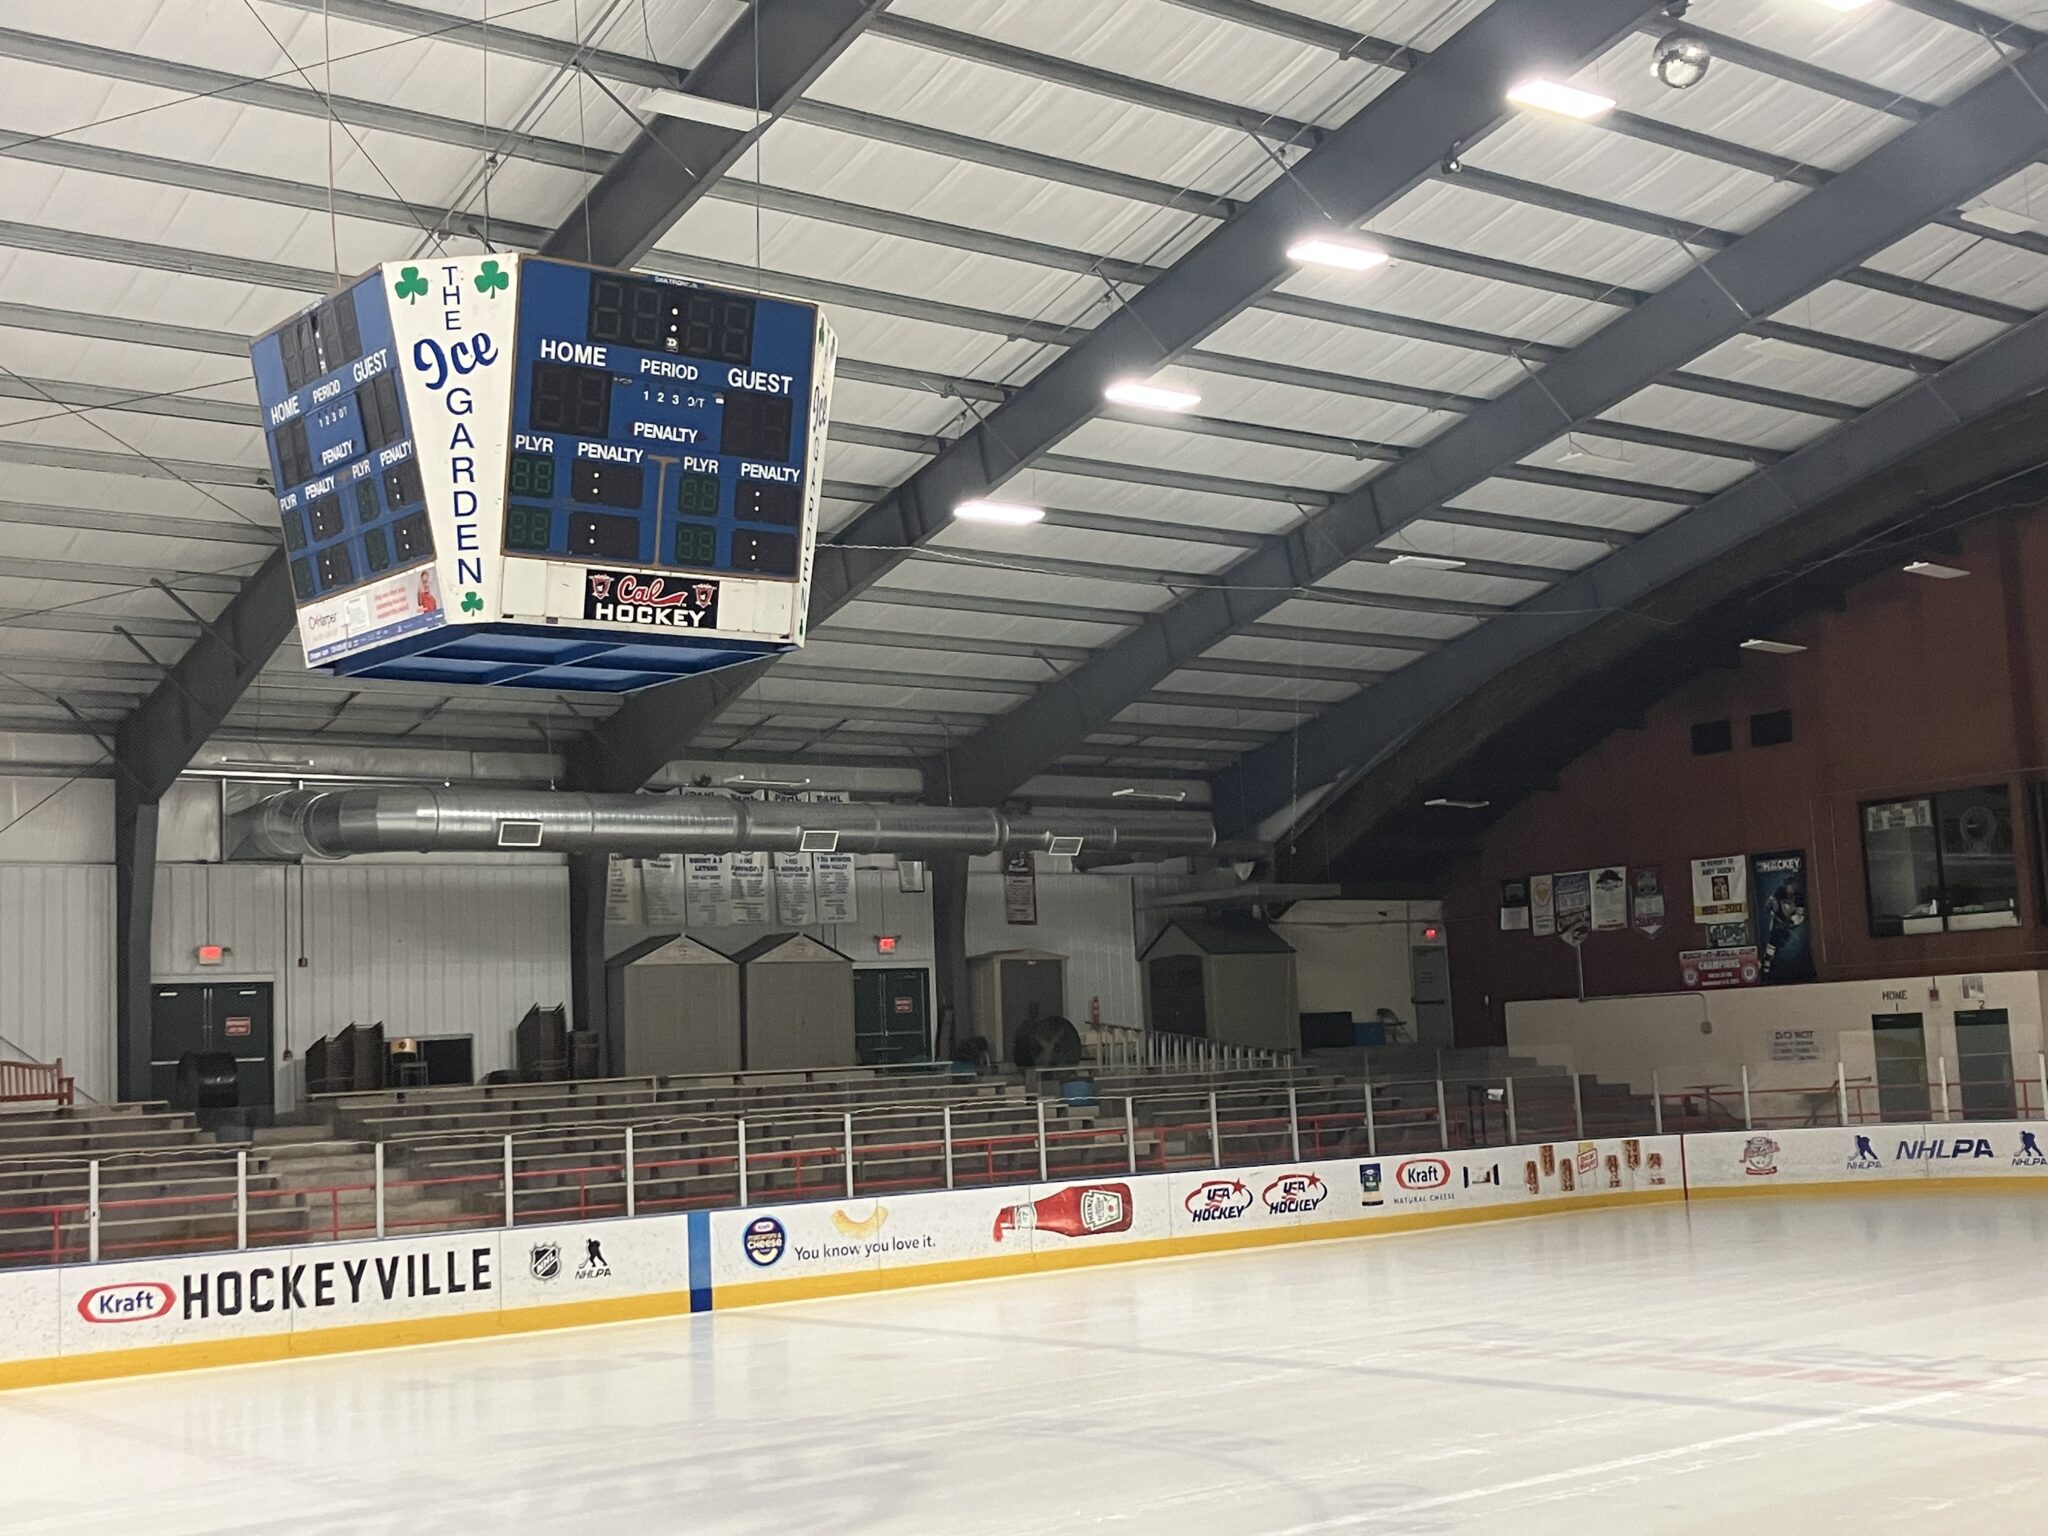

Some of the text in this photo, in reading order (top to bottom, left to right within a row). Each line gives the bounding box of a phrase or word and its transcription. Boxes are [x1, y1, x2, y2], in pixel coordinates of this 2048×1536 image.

[442, 266, 462, 331] THE
[353, 348, 388, 383] GUEST
[540, 339, 607, 366] HOME
[640, 358, 699, 380] PERIOD
[728, 367, 793, 395] GUEST
[312, 379, 341, 404] PERIOD
[643, 390, 649, 401] 1
[657, 391, 665, 403] 2
[671, 394, 680, 405] 3
[271, 395, 300, 425] HOME
[633, 421, 698, 443] PENALTY
[321, 439, 354, 466] PENALTY
[351, 440, 413, 479] PLYR PENALTY
[515, 435, 643, 463] PLYR PENALTY
[683, 456, 800, 483] PLYR PENALTY
[280, 475, 335, 512] PLYR PENALTY
[446, 387, 483, 585] GARDEN
[617, 575, 688, 607] Cal
[595, 602, 706, 628] HOCKEY
[1882, 989, 1908, 1001] HOME
[1895, 1139, 1994, 1160] NHLPA
[2011, 1158, 2048, 1167] NHLPA
[1407, 1165, 1438, 1183] Kraft
[1846, 1160, 1883, 1170] NHLPA
[1269, 1198, 1320, 1215] HOCKEY
[1393, 1193, 1455, 1204] NATURAL CHEESE
[1192, 1205, 1245, 1222] HOCKEY
[794, 1234, 936, 1261] You know you love it.
[536, 1251, 556, 1274] NHL
[575, 1268, 611, 1280] NHLPA
[99, 1248, 492, 1321] Kraft HOCKEYVILLE
